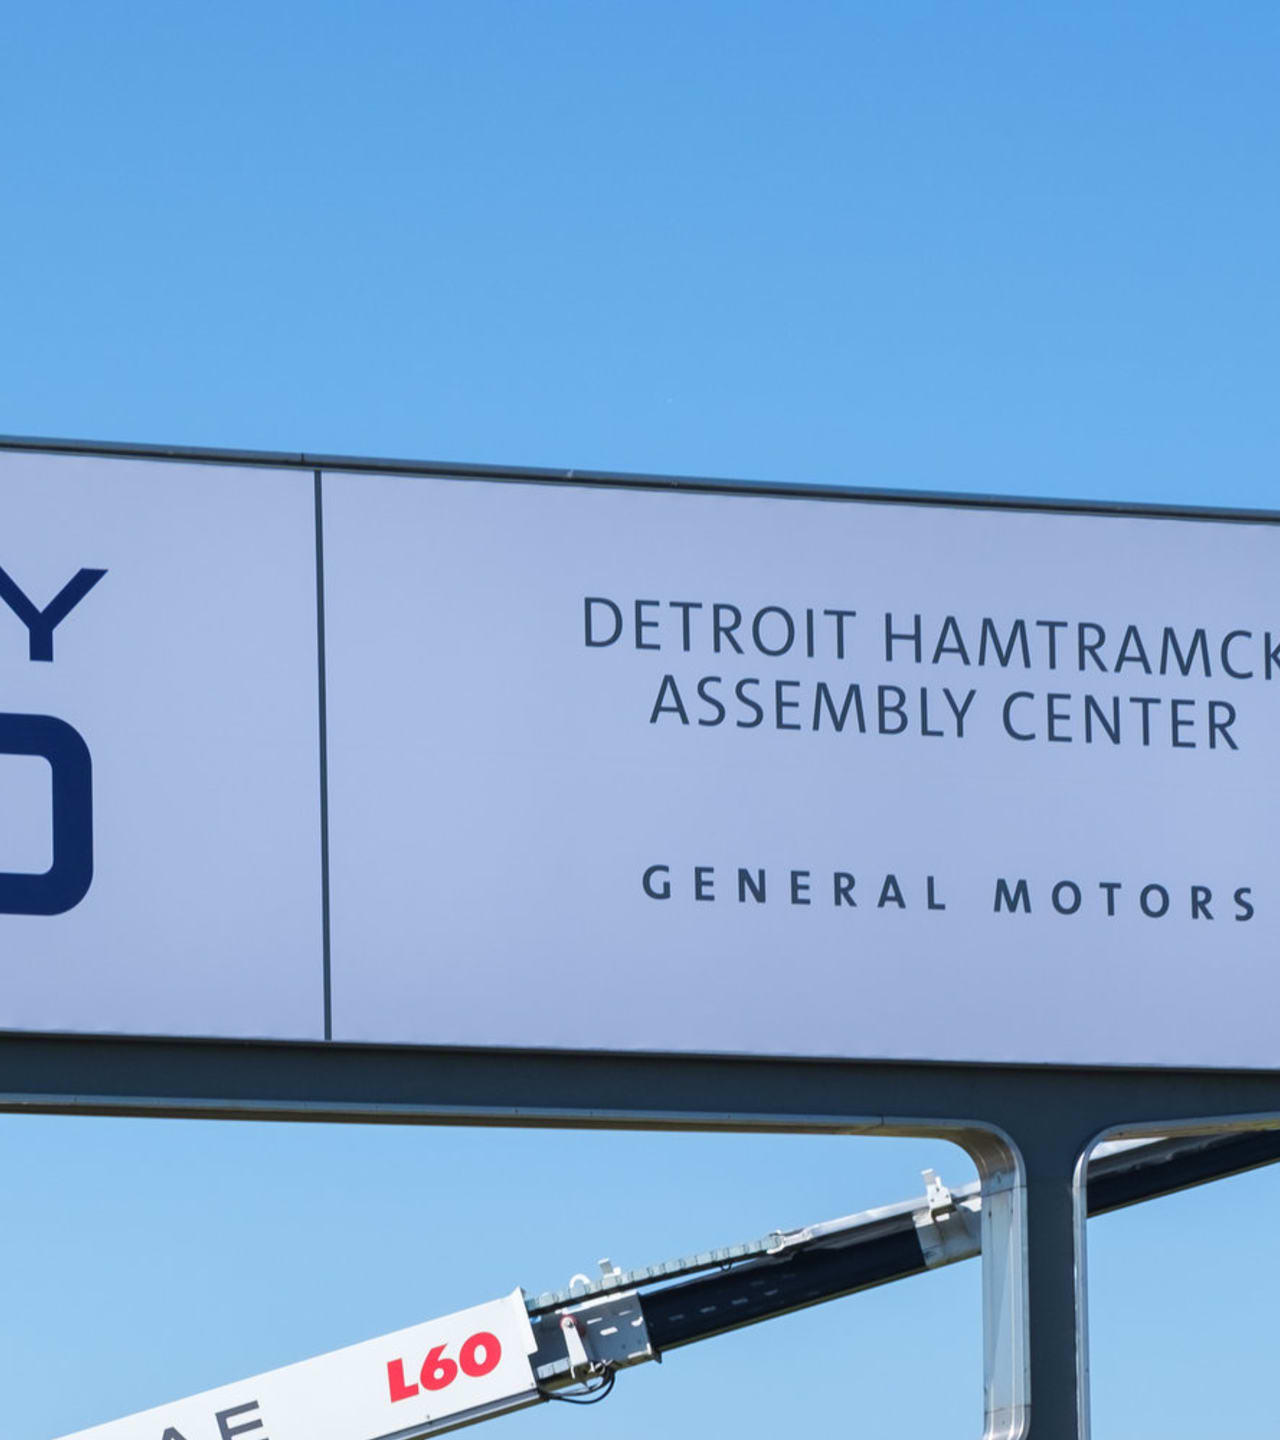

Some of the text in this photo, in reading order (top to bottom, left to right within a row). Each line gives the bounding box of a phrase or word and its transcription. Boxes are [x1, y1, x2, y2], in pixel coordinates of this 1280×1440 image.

[584, 597, 857, 660] DETROIT
[649, 674, 1240, 751] ASSEMBLY CENTER
[642, 864, 1255, 922] GENERAL MOTORS
[387, 1331, 502, 1403] L60
